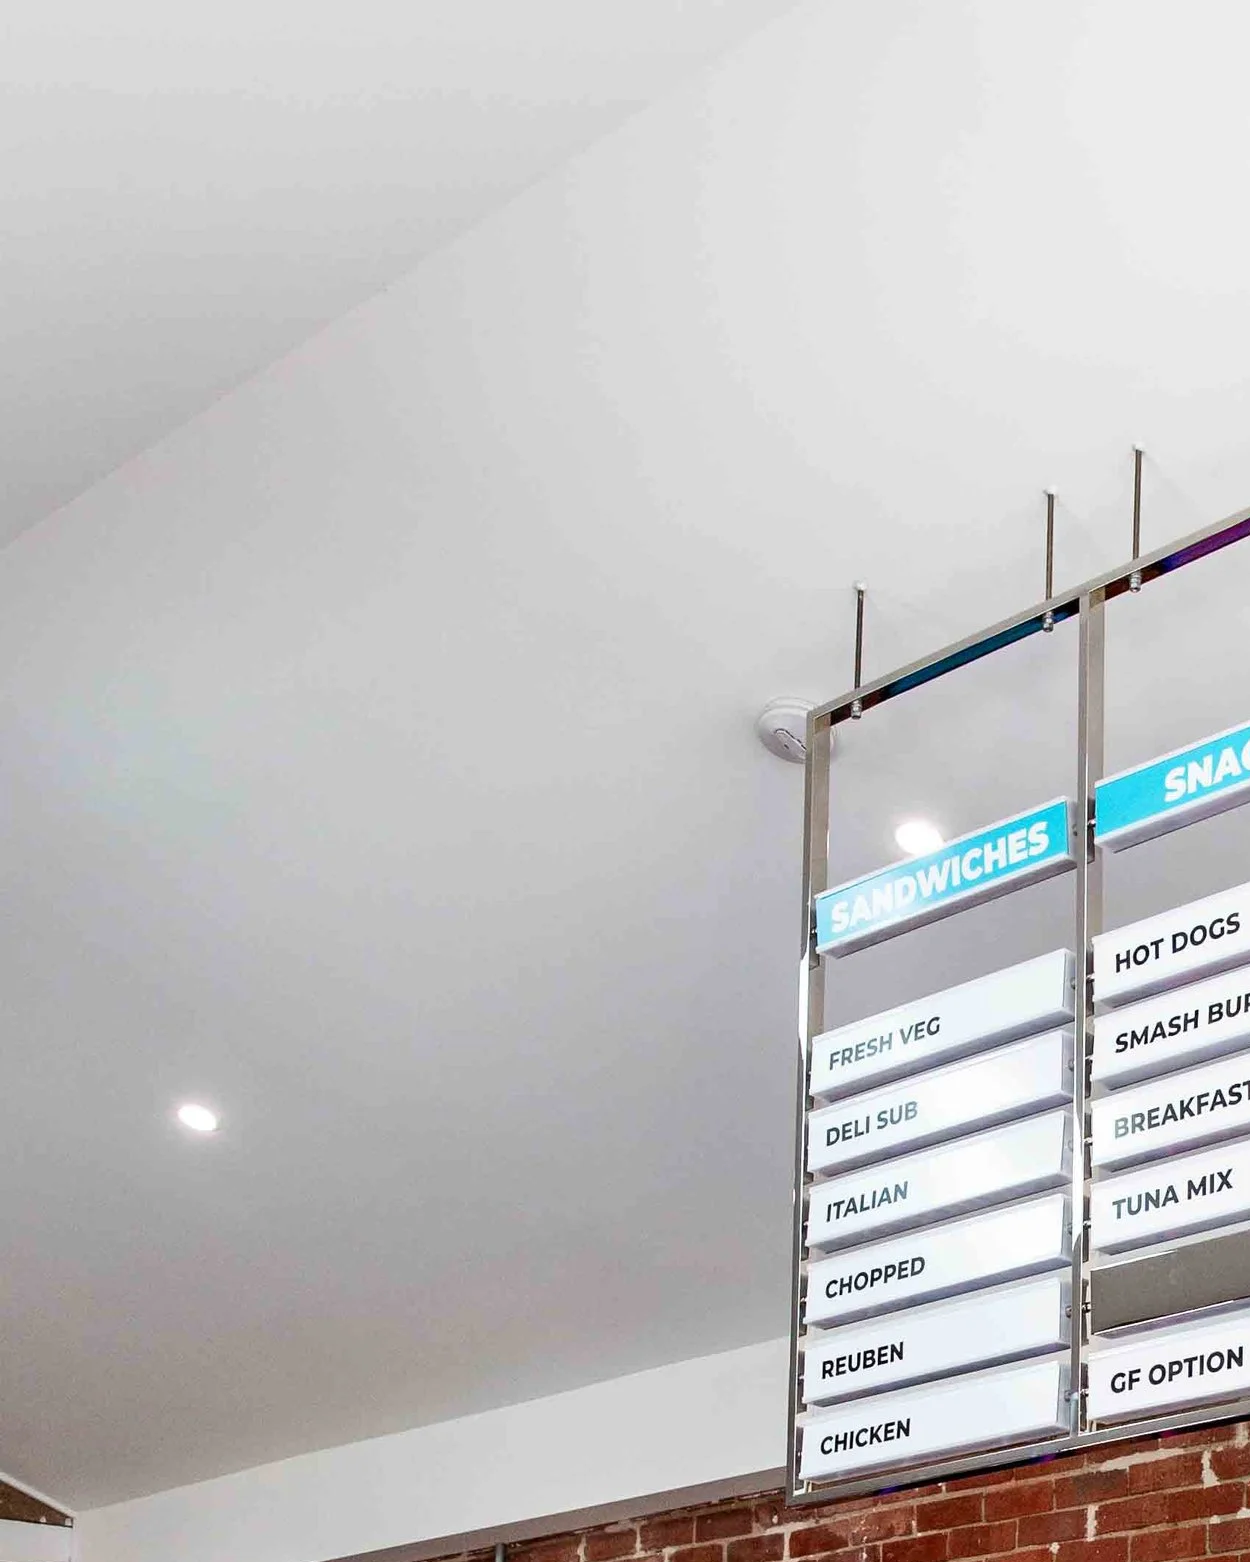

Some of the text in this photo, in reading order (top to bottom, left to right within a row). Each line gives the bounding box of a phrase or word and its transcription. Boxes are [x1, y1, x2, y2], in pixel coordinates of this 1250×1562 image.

[831, 822, 1050, 934] SANDWICHES
[1116, 913, 1240, 973] HOT DOGS
[830, 1017, 941, 1070] FRESH VEG
[1116, 1010, 1199, 1053] SMASH
[827, 1101, 917, 1146] DELI SUB
[826, 1181, 908, 1222] ITALIAN
[1112, 1169, 1232, 1219] TUNA MIX
[826, 1257, 925, 1298] CHOPPED
[822, 1342, 903, 1379] REUBEN
[1111, 1346, 1243, 1393] GF OPTION
[821, 1418, 910, 1455] CHICKEN
